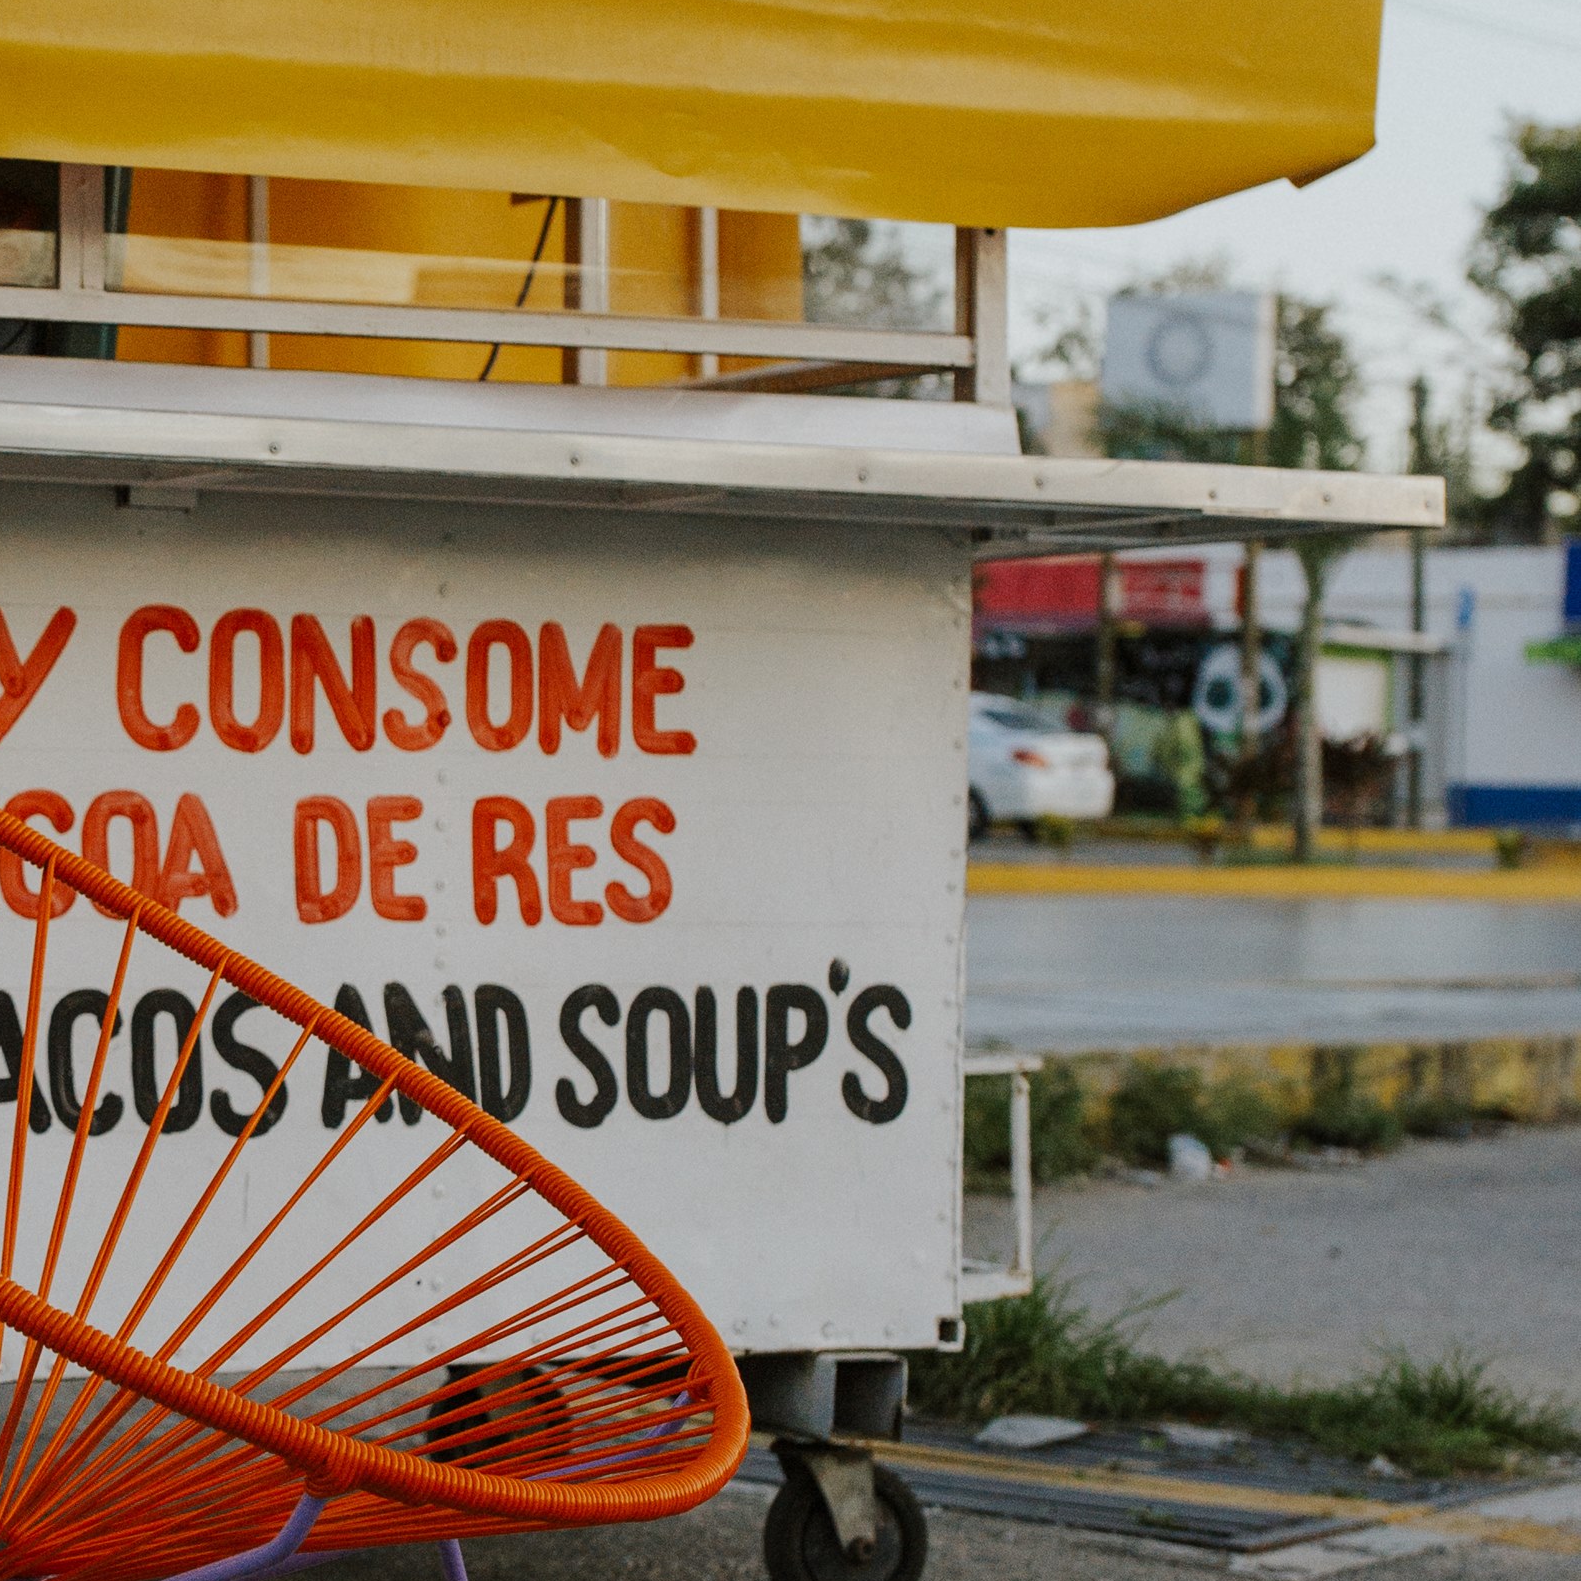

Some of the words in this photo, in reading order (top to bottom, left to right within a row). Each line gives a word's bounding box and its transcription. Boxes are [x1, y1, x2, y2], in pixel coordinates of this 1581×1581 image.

[116, 604, 697, 758] CONSOME
[295, 794, 429, 924] DE
[472, 795, 676, 926] RES
[320, 982, 532, 1129] AND
[556, 958, 912, 1128] SOUP'S
